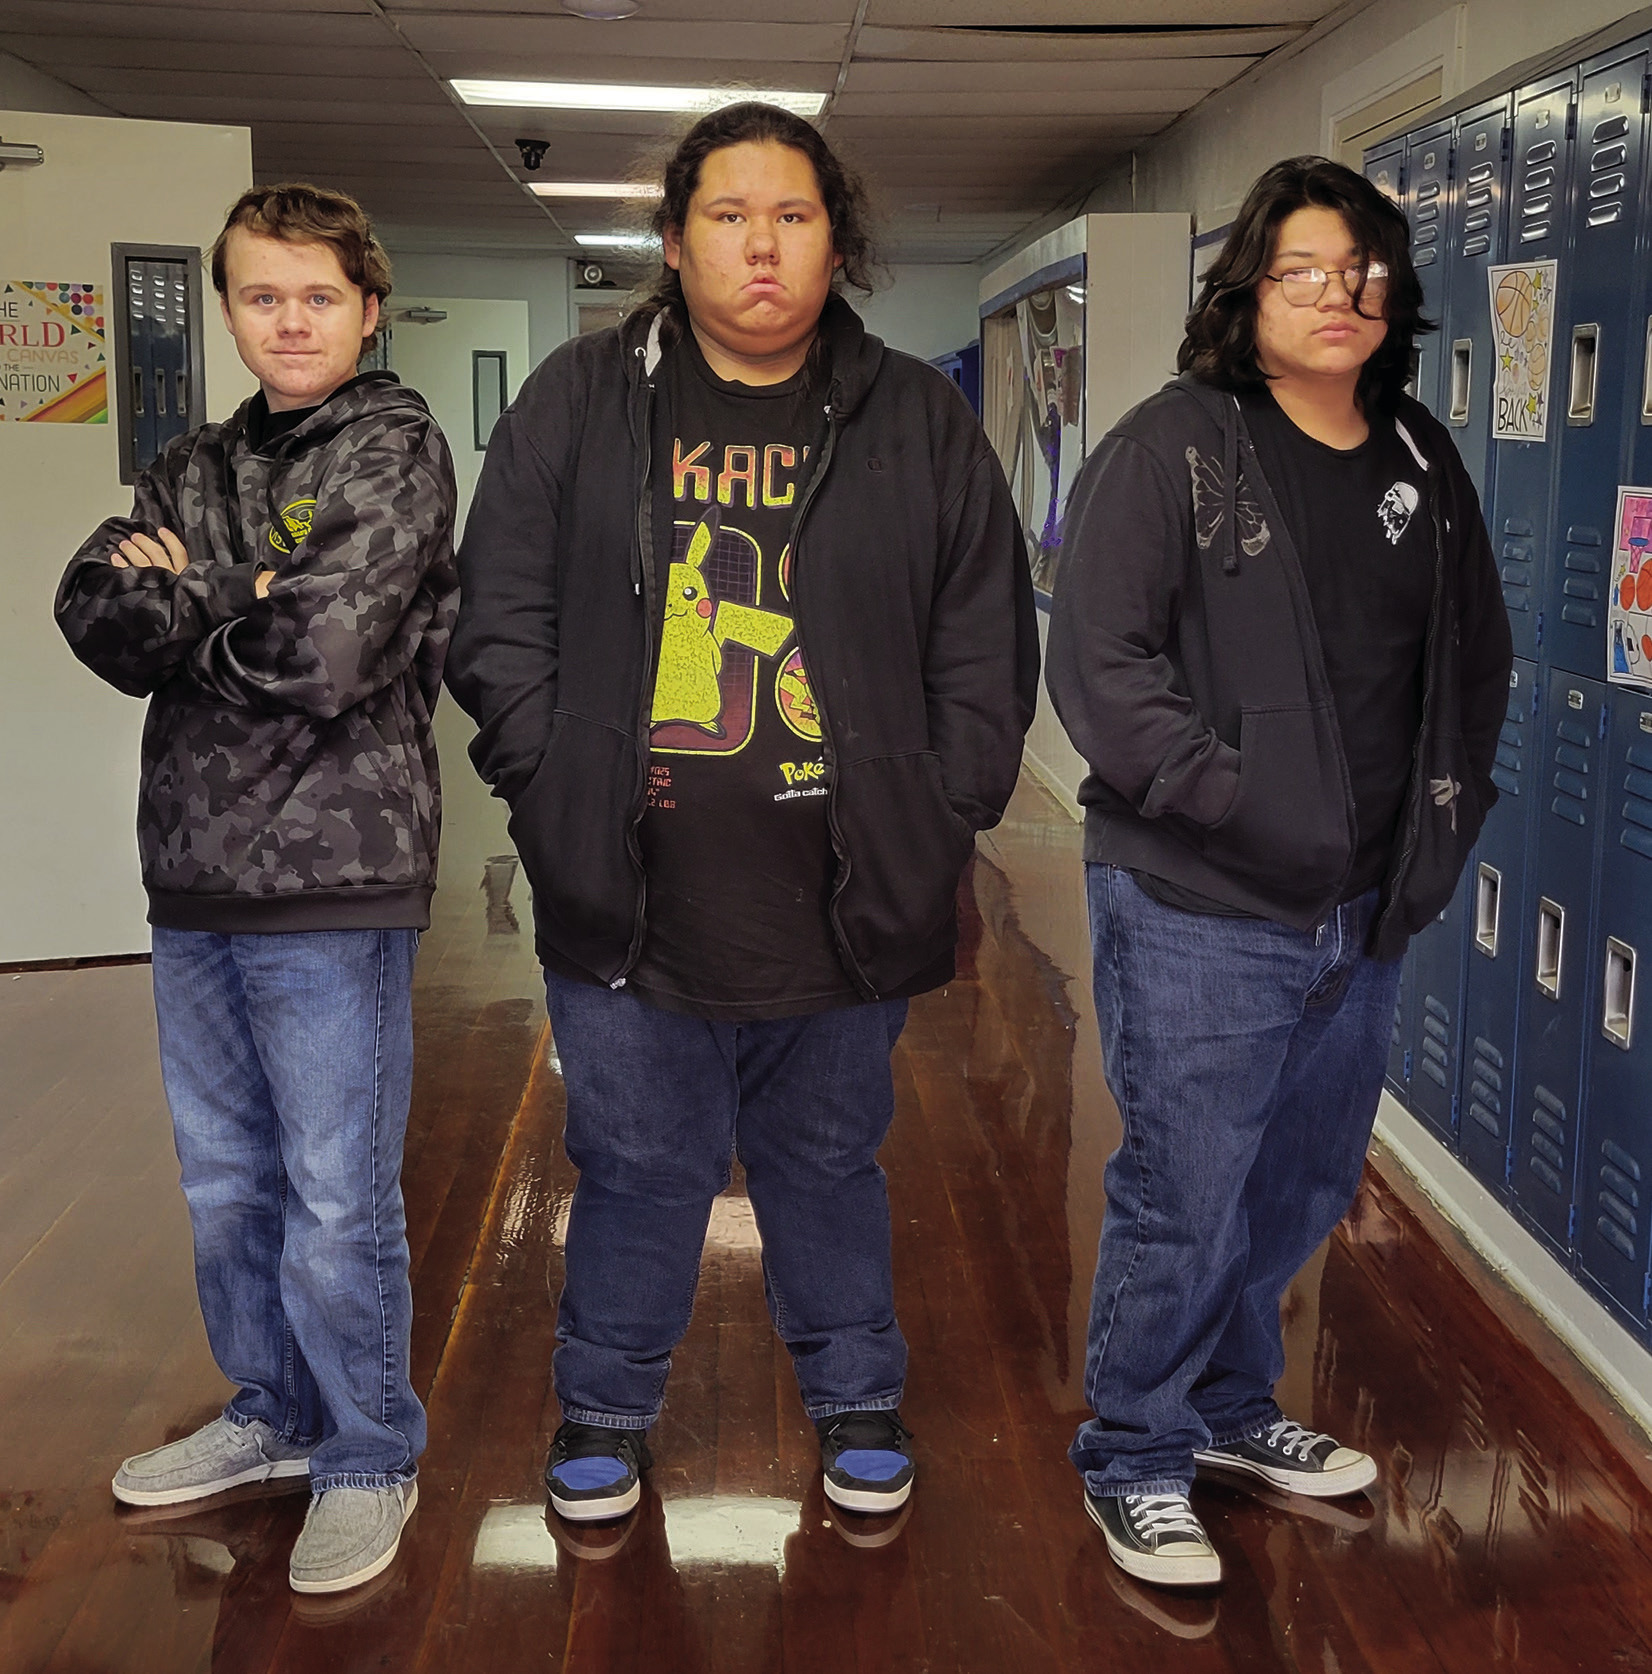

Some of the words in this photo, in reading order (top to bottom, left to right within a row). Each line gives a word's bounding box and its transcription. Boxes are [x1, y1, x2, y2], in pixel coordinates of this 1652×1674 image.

[0, 321, 66, 347] RLD
[6, 348, 79, 364] CANVAS
[3, 363, 20, 371] THE
[1497, 397, 1528, 432] BACK
[672, 437, 811, 510] KAC
[773, 789, 801, 801] Gotta
[802, 787, 828, 796] catch
